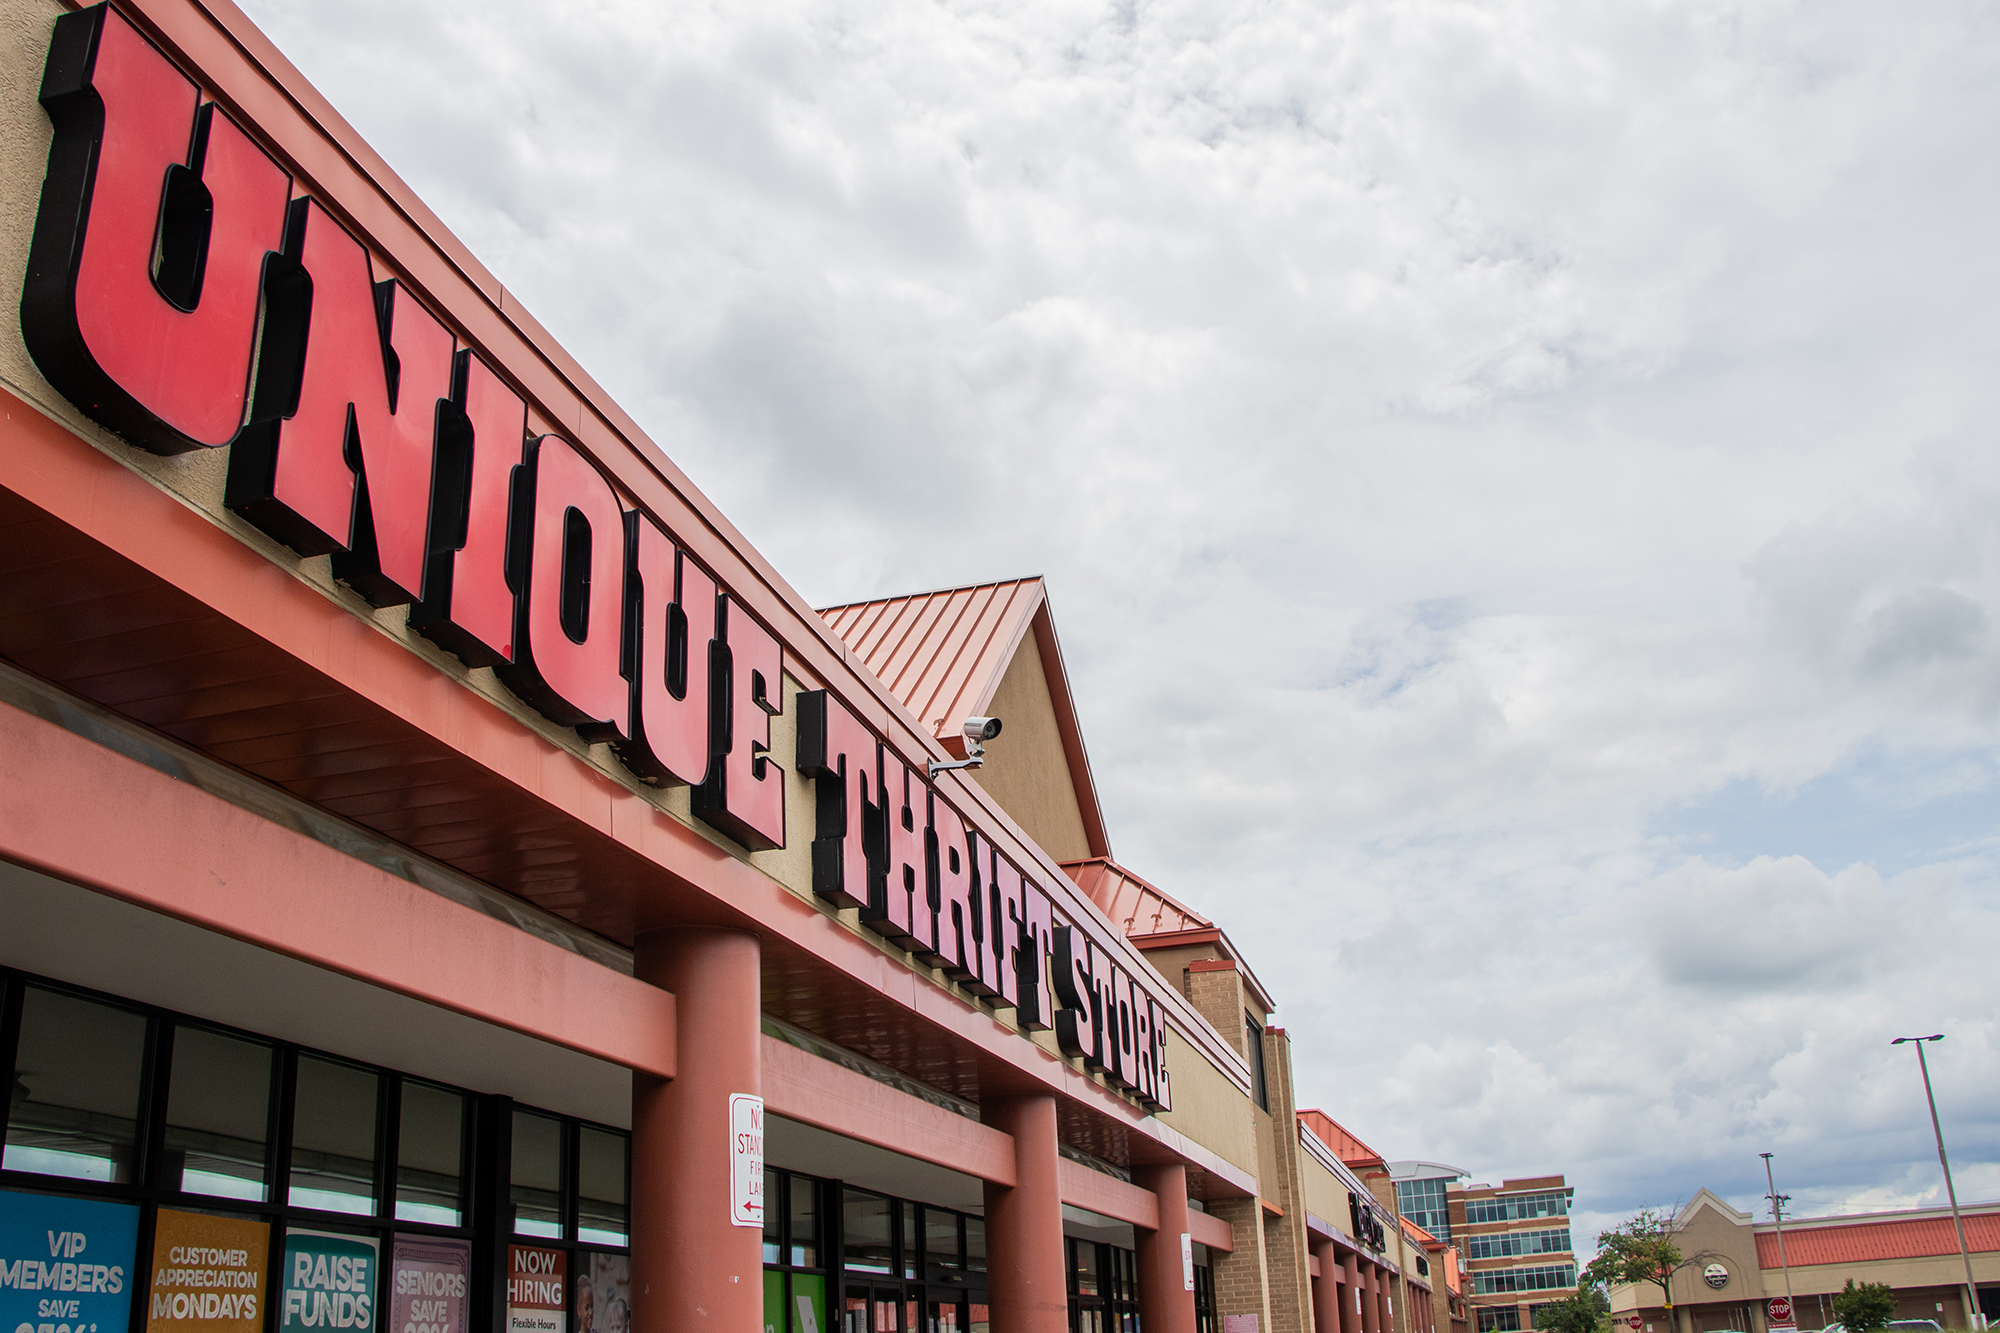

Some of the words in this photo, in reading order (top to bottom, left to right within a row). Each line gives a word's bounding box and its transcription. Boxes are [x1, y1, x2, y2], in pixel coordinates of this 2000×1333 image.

[20, 1, 785, 851] UNIQUE
[797, 689, 1053, 1031] THRIFT
[1053, 925, 1172, 1112] STORE
[750, 1107, 762, 1131] NO
[749, 1180, 763, 1197] LAN
[47, 1230, 87, 1258] VIP
[169, 1246, 248, 1267] CUSTOMER
[293, 1251, 368, 1292] RAISE
[515, 1249, 556, 1275] NOW
[0, 1258, 124, 1294] MEMBERS
[155, 1268, 258, 1288] APPRECIATION
[396, 1269, 466, 1298] SENIORS
[507, 1278, 562, 1305] HIRING
[38, 1298, 80, 1318] SAVE
[152, 1292, 257, 1320] MONDAYS
[284, 1289, 371, 1329] FUNDS
[410, 1299, 448, 1322] SAVE
[1770, 1304, 1790, 1315] STOP
[512, 1317, 537, 1329] Flexible
[537, 1320, 556, 1330] Hours
